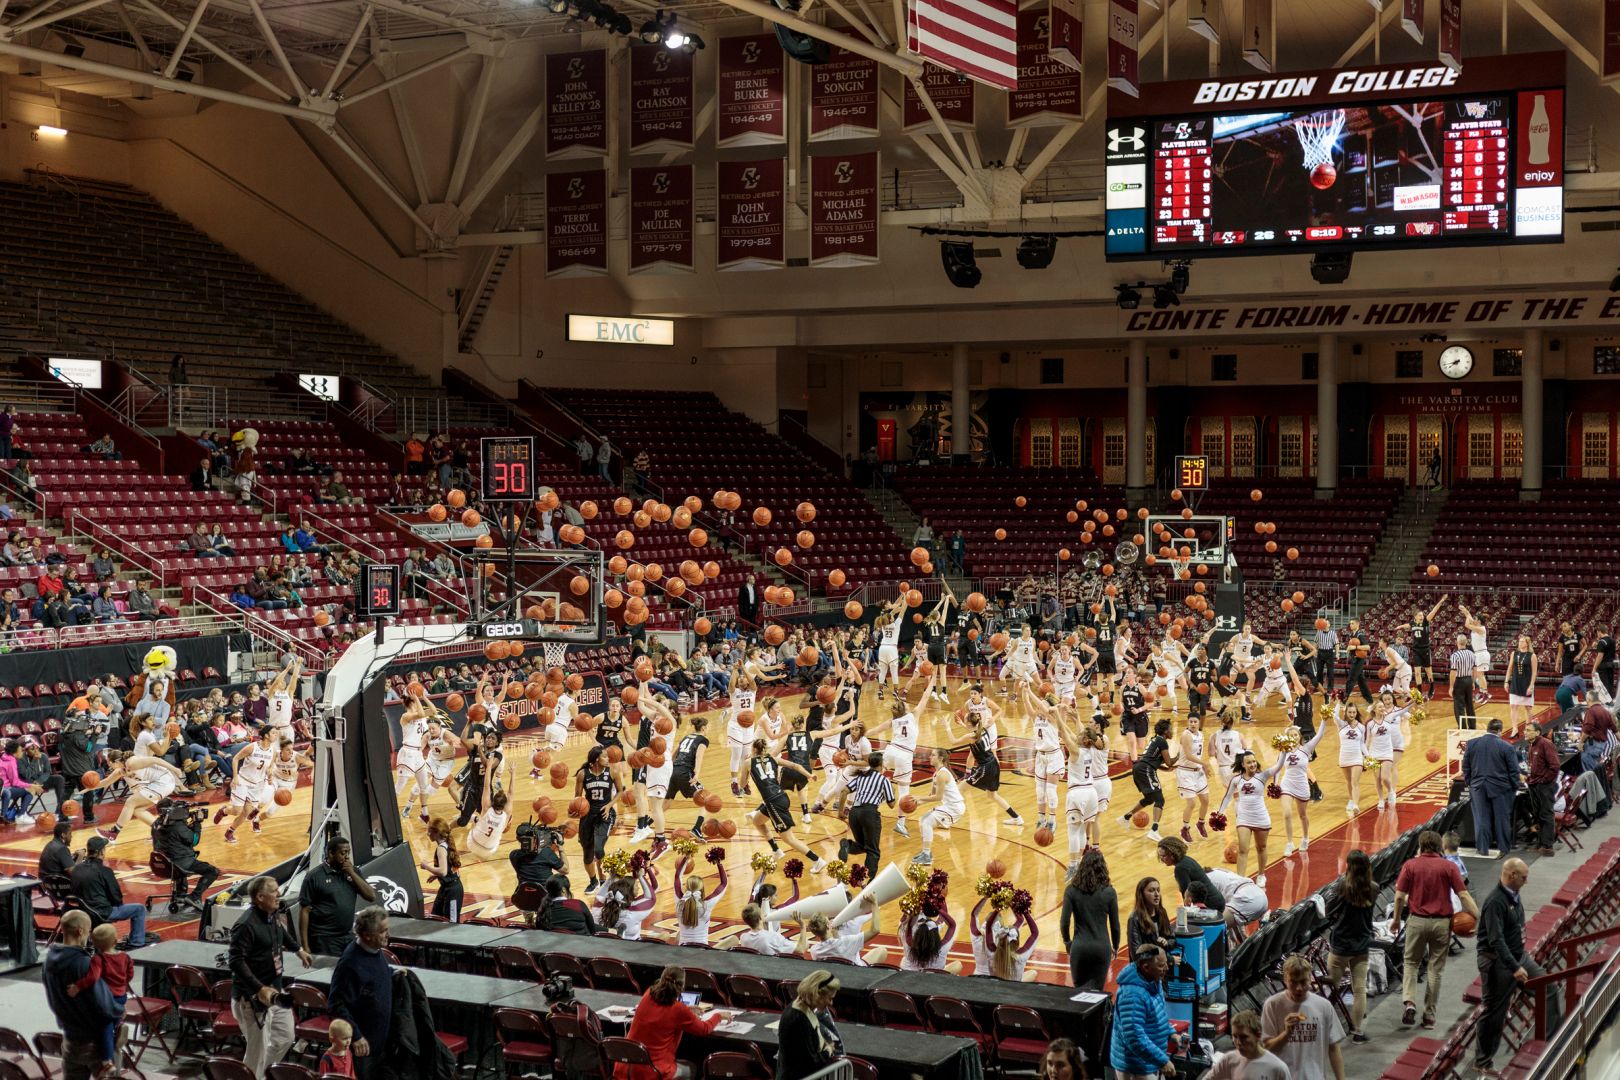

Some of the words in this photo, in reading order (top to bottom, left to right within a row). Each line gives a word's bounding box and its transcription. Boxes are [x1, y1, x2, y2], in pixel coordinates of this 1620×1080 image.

[734, 78, 769, 90] BERNIE
[816, 72, 830, 84] ED
[927, 74, 952, 86] SILK
[564, 80, 589, 93] JOHN
[652, 87, 671, 97] RAY
[823, 80, 866, 95] SONGIN
[1193, 77, 1318, 105] BOSTON
[1328, 67, 1463, 95] COLLEGE
[733, 89, 770, 101] BURKE
[552, 101, 586, 114] KELLEY
[636, 96, 688, 109] CHAISSON
[750, 102, 776, 111] HOCKEY
[916, 100, 962, 111] 199-53
[641, 121, 683, 132] 1940-42
[1451, 121, 1479, 130] PLAYER
[1479, 120, 1502, 128] STATS
[1161, 141, 1186, 149] PLAYER
[1455, 140, 1463, 150] 2
[1165, 159, 1173, 169] 2
[1183, 158, 1191, 168] 2
[1204, 156, 1211, 166] 4
[1450, 167, 1463, 178] 14
[1497, 165, 1506, 175] 7
[1524, 170, 1556, 183] enjoy
[1165, 184, 1172, 194] 4
[1497, 178, 1506, 189] 4
[813, 190, 846, 199] RETIRED
[736, 202, 766, 216] JOHN
[822, 197, 868, 211] MICHAEL
[1516, 204, 1562, 215] COMCAST
[562, 212, 591, 224] TERRY
[654, 208, 670, 220] JOE
[731, 212, 772, 225] BAGLEY
[825, 209, 865, 222] ADAMS
[1516, 213, 1562, 224] BUSINESS
[553, 222, 601, 236] DRISCOLL
[641, 218, 683, 231] MULLEN
[836, 222, 877, 231] BASKETBALL
[1373, 225, 1397, 235] 35
[1116, 226, 1145, 236] DELTA
[730, 237, 773, 248] 1979-82
[824, 234, 866, 246] 1981-85
[641, 242, 683, 254] 1975-79
[1126, 308, 1230, 332] CONTE
[1235, 304, 1352, 329] FORUM
[1363, 301, 1461, 326] HOME
[1464, 299, 1514, 323] OF
[1521, 297, 1589, 321] THE
[1400, 396, 1424, 406] THE
[1429, 395, 1480, 405] VARSITY
[1485, 395, 1519, 405] CLUB
[1182, 459, 1205, 469] 14:43
[494, 462, 526, 493] 30
[1182, 469, 1203, 486] 30
[373, 586, 389, 607] 30
[486, 622, 524, 638] GEICO
[1098, 629, 1113, 641] 41
[1195, 671, 1207, 680] 44
[275, 700, 283, 712] 5
[740, 698, 751, 709] 23
[1126, 697, 1136, 706] 11
[901, 725, 908, 738] 4
[679, 738, 697, 753] 41
[791, 736, 808, 752] 14
[1224, 744, 1231, 756] 4
[756, 761, 776, 780] 14
[1084, 766, 1091, 779] 5
[591, 789, 605, 801] 21
[485, 826, 495, 838] 3
